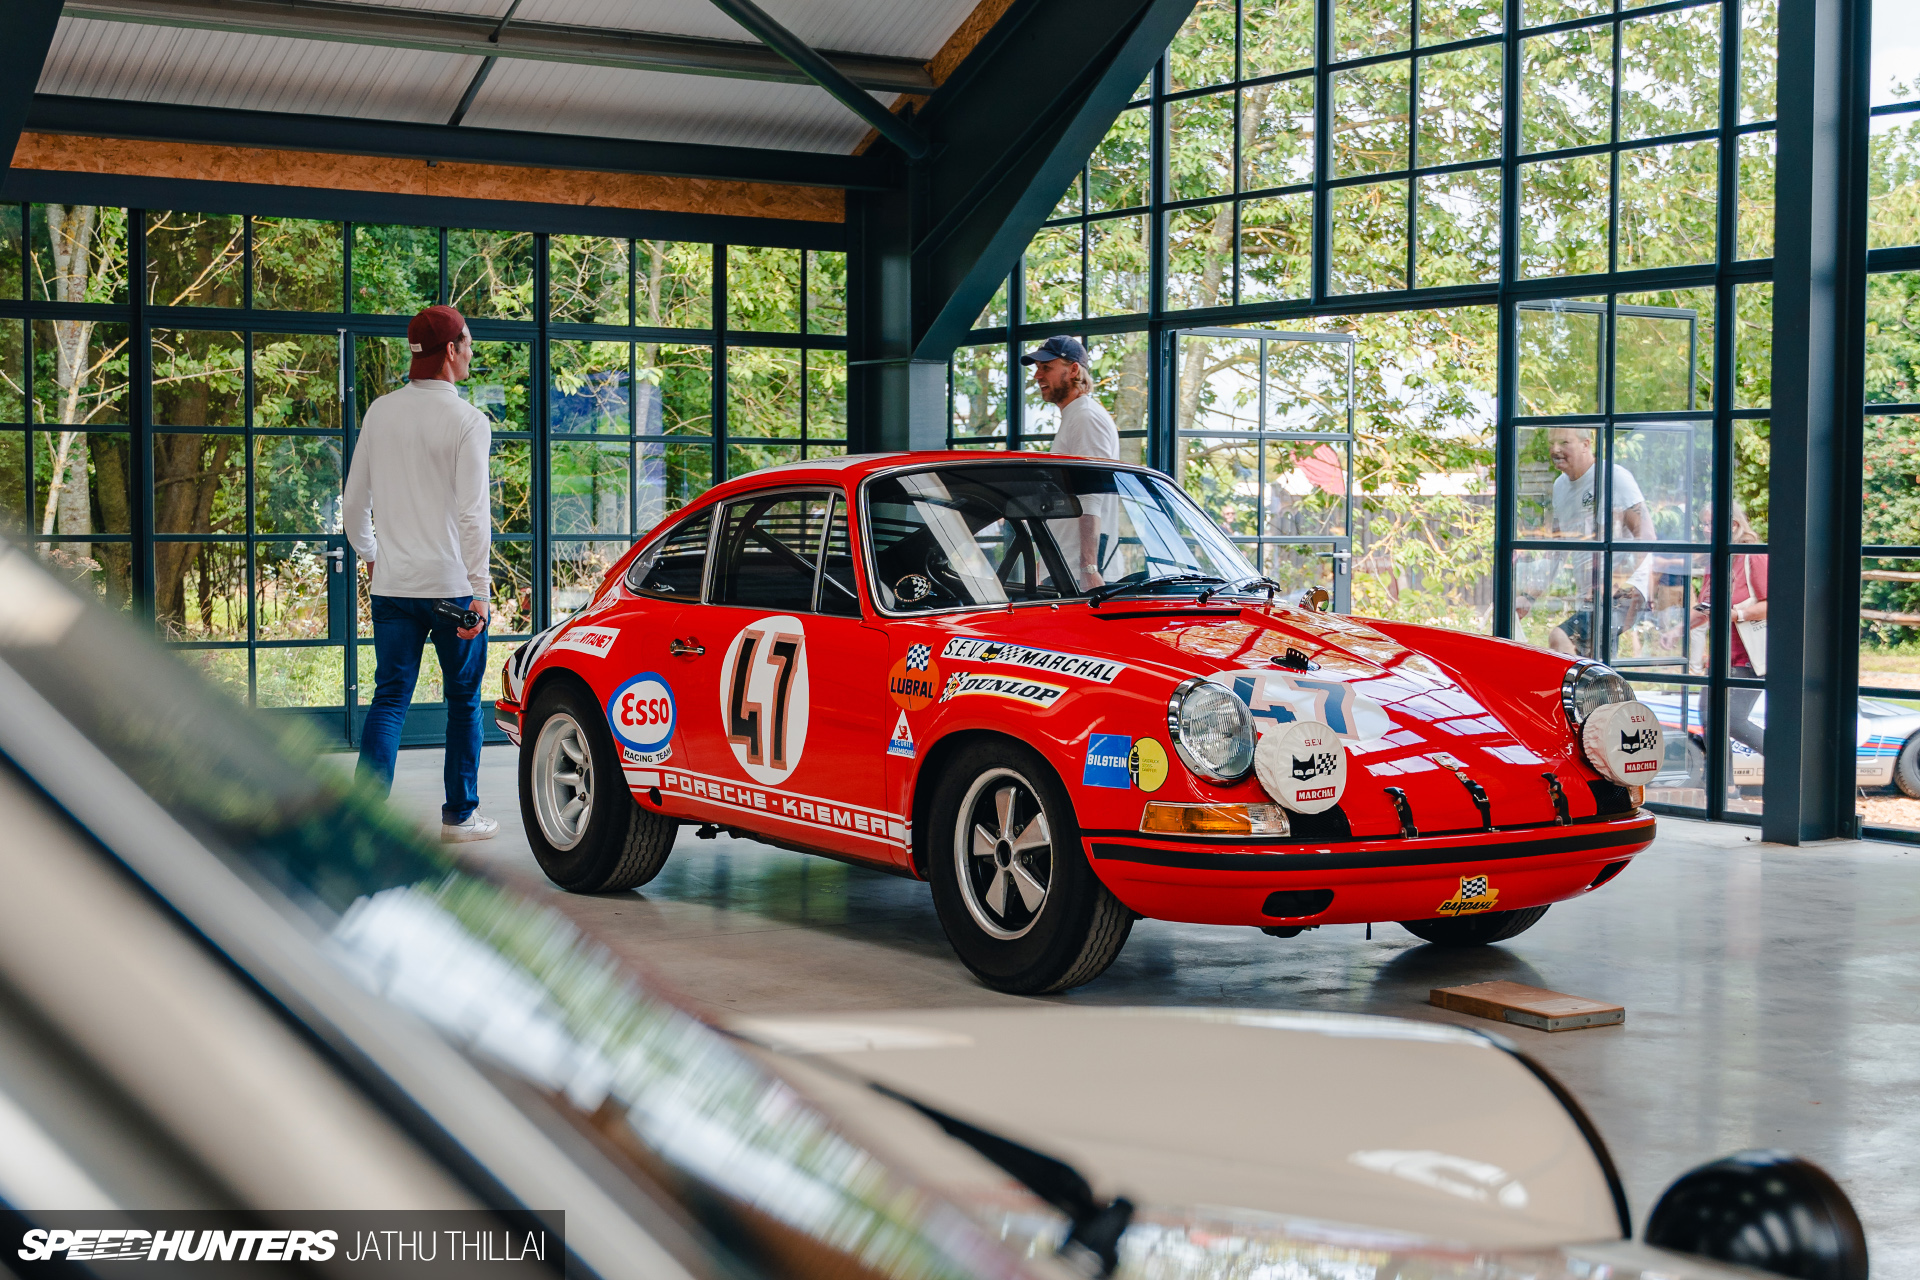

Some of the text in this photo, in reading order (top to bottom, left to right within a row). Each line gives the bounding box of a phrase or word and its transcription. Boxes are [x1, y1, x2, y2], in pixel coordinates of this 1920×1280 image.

[1017, 651, 1116, 682] MARCHAL
[890, 677, 934, 699] LUBRAL
[959, 678, 1062, 701] DUNLOP
[727, 628, 806, 771] 47
[624, 747, 672, 763] RACING TEAM
[1087, 753, 1127, 768] BILSTEIN
[1626, 761, 1656, 772] MARCHAL
[1298, 787, 1334, 800] MARCHAL
[664, 773, 887, 836] PORSCHE KREMER
[1439, 900, 1493, 916] BARDAHL
